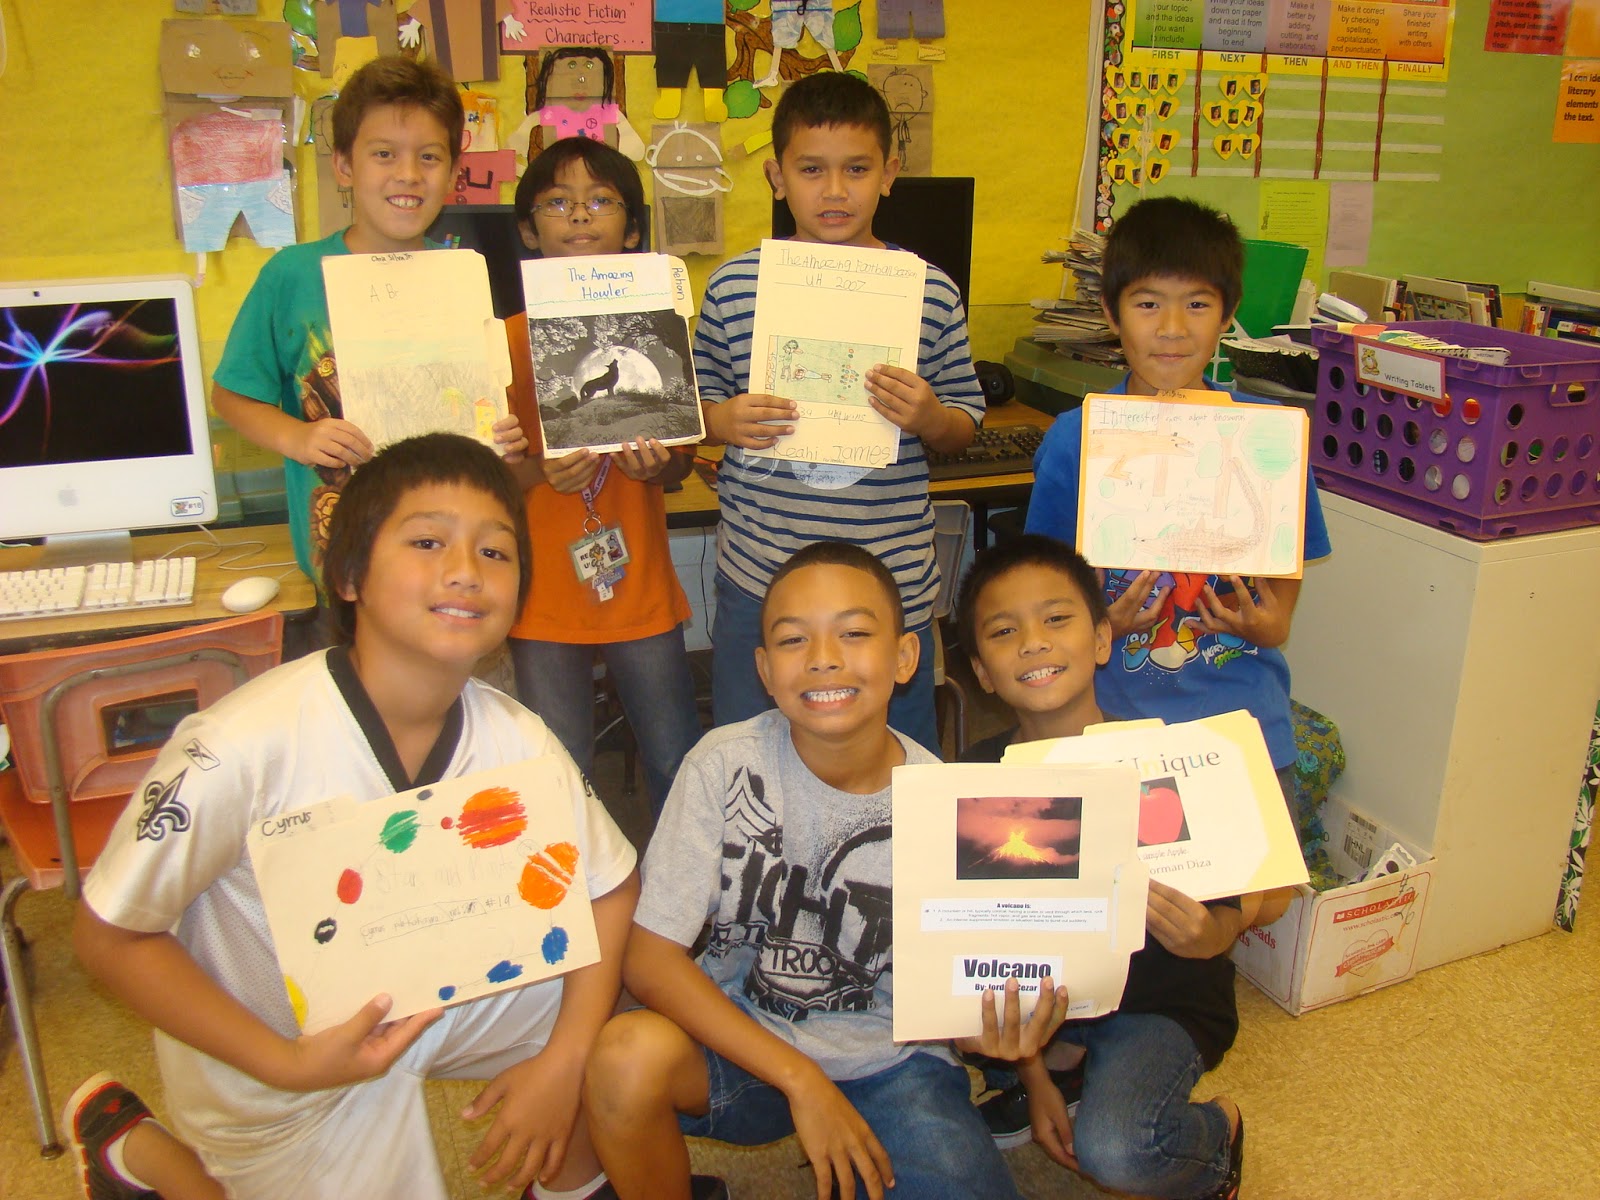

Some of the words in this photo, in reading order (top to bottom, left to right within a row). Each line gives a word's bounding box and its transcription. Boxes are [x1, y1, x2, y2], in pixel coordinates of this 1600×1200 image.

[1171, 4, 1188, 13] topic
[1337, 4, 1355, 13] Make
[1363, 7, 1385, 15] correct
[1403, 9, 1421, 17] Share
[1175, 14, 1194, 22] ideas
[1242, 9, 1262, 18] paper
[1208, 17, 1222, 25] and
[1247, 19, 1263, 27] from
[1341, 14, 1350, 23] by
[1351, 15, 1380, 26] checking
[1407, 20, 1431, 28] finished
[1218, 28, 1252, 37] beginning
[1407, 30, 1428, 39] writing
[1160, 35, 1185, 43] include
[1399, 39, 1412, 47] with
[1331, 44, 1344, 52] and
[1152, 50, 1180, 60] FIRST
[1220, 53, 1246, 63] NEXT
[1284, 57, 1308, 66] THEN
[1333, 60, 1352, 69] AND
[1356, 61, 1380, 70] THEN
[1397, 64, 1433, 73] FINALLY
[1589, 74, 1600, 82] ide
[1567, 86, 1597, 97] literary
[1566, 99, 1599, 108] elements
[1563, 112, 1577, 121] the
[780, 248, 801, 266] The
[568, 267, 586, 282] The
[591, 267, 634, 282] Amazing
[836, 276, 867, 291] 2007
[581, 283, 629, 300] Howler
[1384, 373, 1409, 389] Writing
[1411, 379, 1436, 392] Tablets
[774, 438, 819, 460] Keahi
[832, 445, 891, 465] James
[1150, 864, 1184, 876] orman
[1187, 859, 1213, 870] Diza
[1343, 912, 1399, 932] www.scholastic.co
[963, 958, 1051, 979] Volcano
[975, 983, 987, 992] By:
